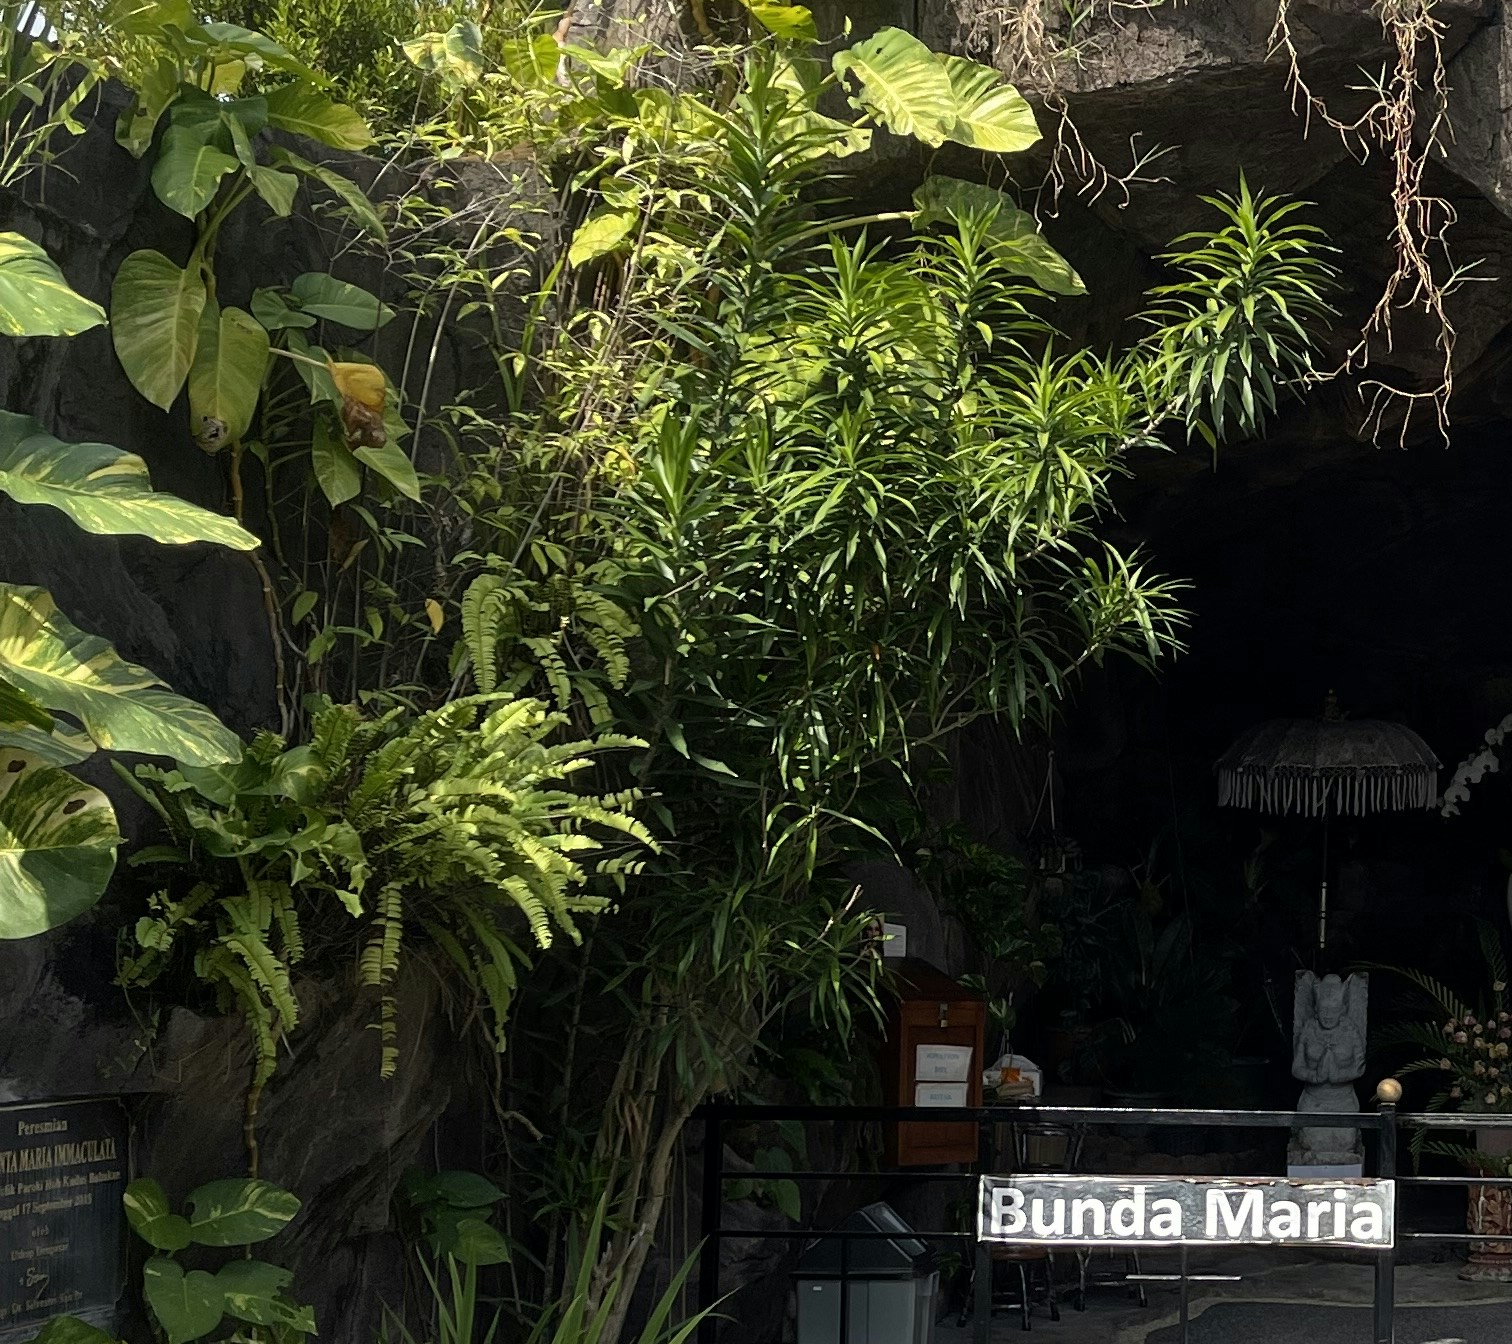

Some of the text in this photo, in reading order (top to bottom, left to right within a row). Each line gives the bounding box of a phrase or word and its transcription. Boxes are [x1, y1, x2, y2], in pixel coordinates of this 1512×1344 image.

[18, 1118, 67, 1136] Peresmian
[0, 1137, 116, 1173] NTA MARIA IMMACULATA
[32, 1198, 72, 1214] September
[991, 1185, 1383, 1240] Bunda Maria
